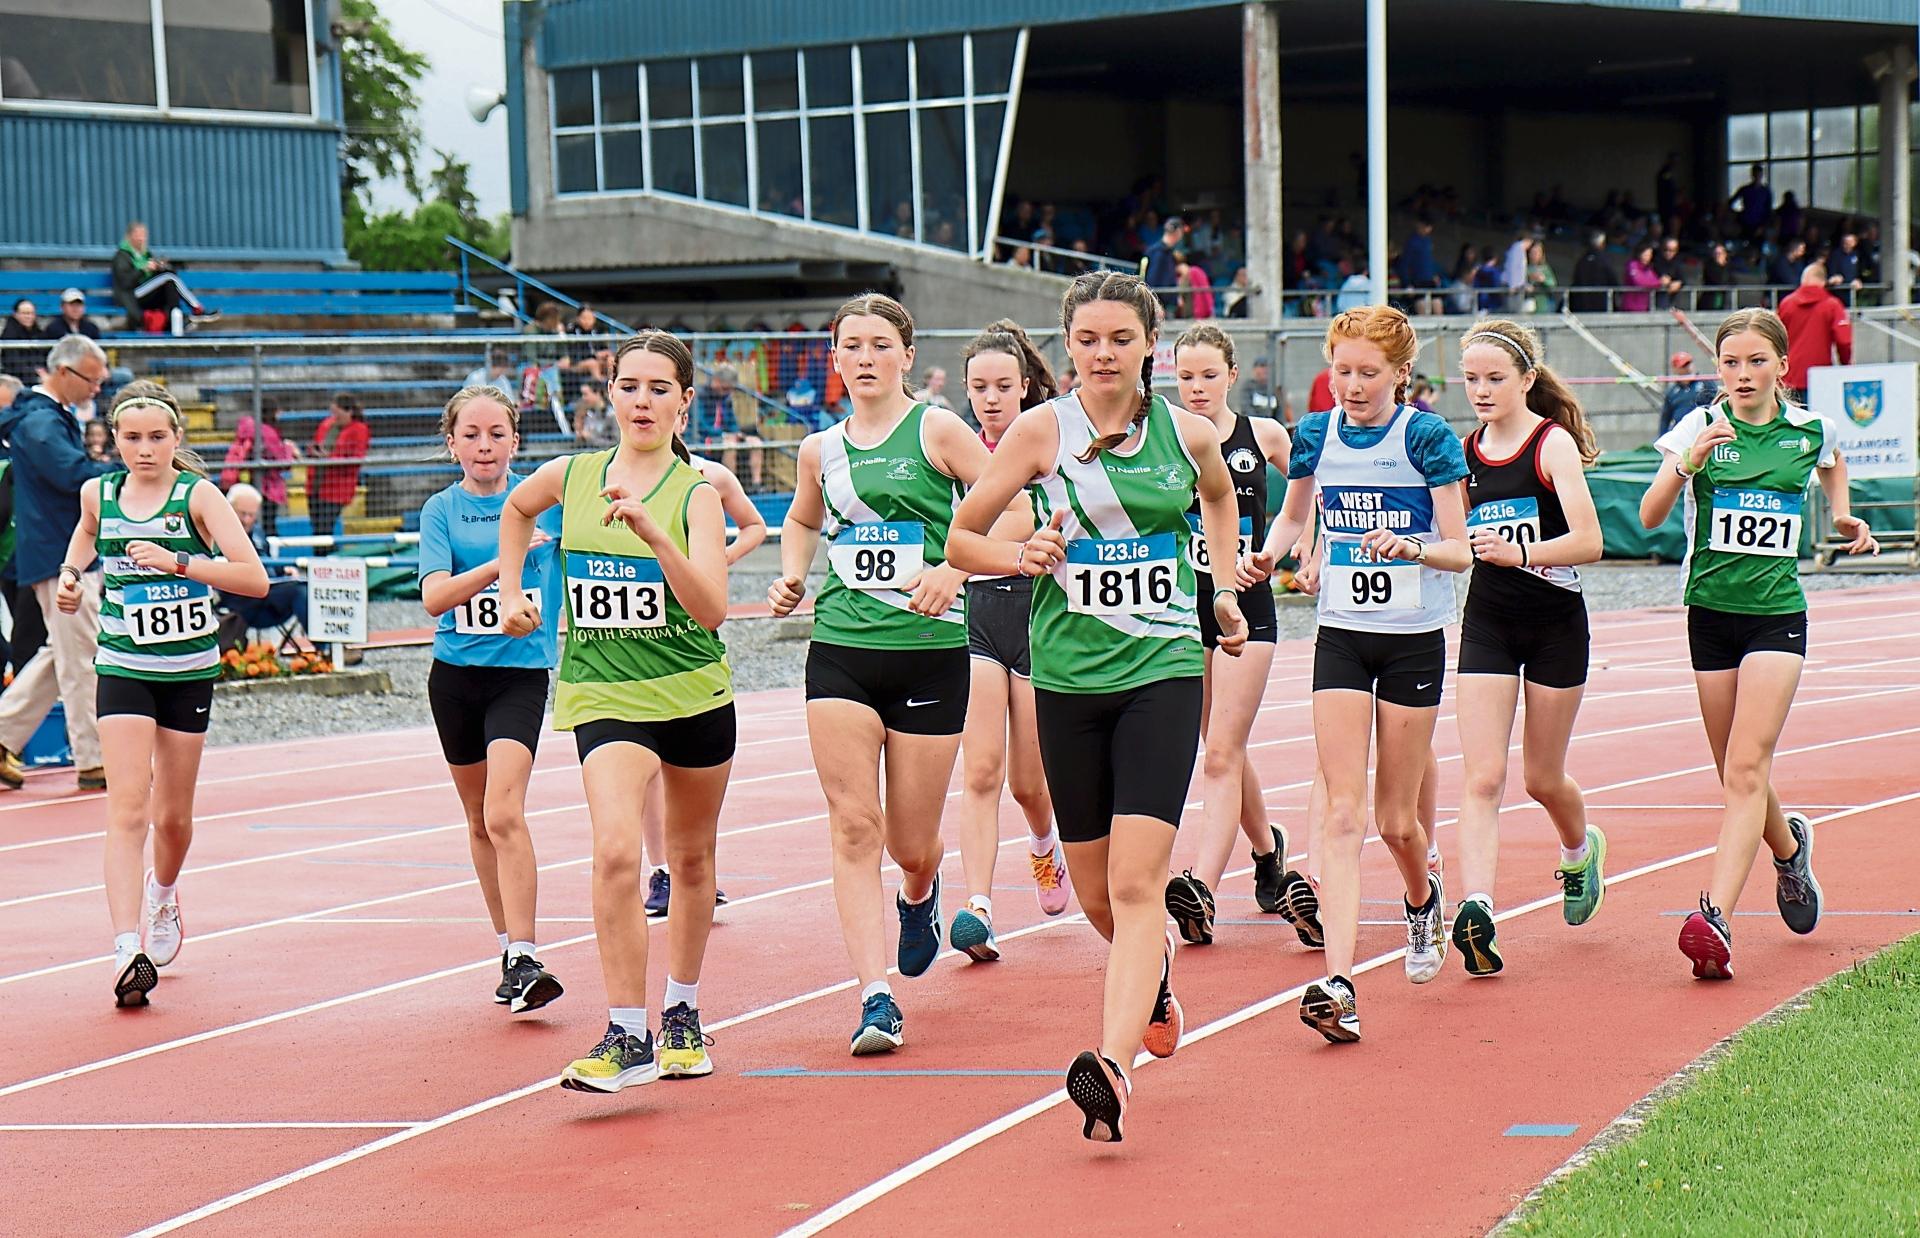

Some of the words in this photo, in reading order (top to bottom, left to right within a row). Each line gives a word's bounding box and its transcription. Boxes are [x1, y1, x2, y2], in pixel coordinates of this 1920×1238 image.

[1338, 492, 1383, 511] WEST
[1738, 492, 1781, 510] 123.ie
[1325, 510, 1411, 529] WATERFORD
[1480, 504, 1515, 521] 123.ie
[855, 526, 899, 542] 123.ie
[1719, 513, 1791, 549] 1821
[1096, 542, 1149, 561] 123.ie
[587, 560, 636, 578] 123.ie
[855, 549, 896, 581] 98
[145, 584, 189, 600] 123.ie
[314, 587, 360, 601] ELECTRIC
[1075, 565, 1171, 607] 1816
[1351, 571, 1392, 605] 99
[320, 604, 354, 618] TIMING
[571, 584, 658, 620] 1813
[131, 602, 207, 637] 1815
[324, 621, 350, 635] ZONE
